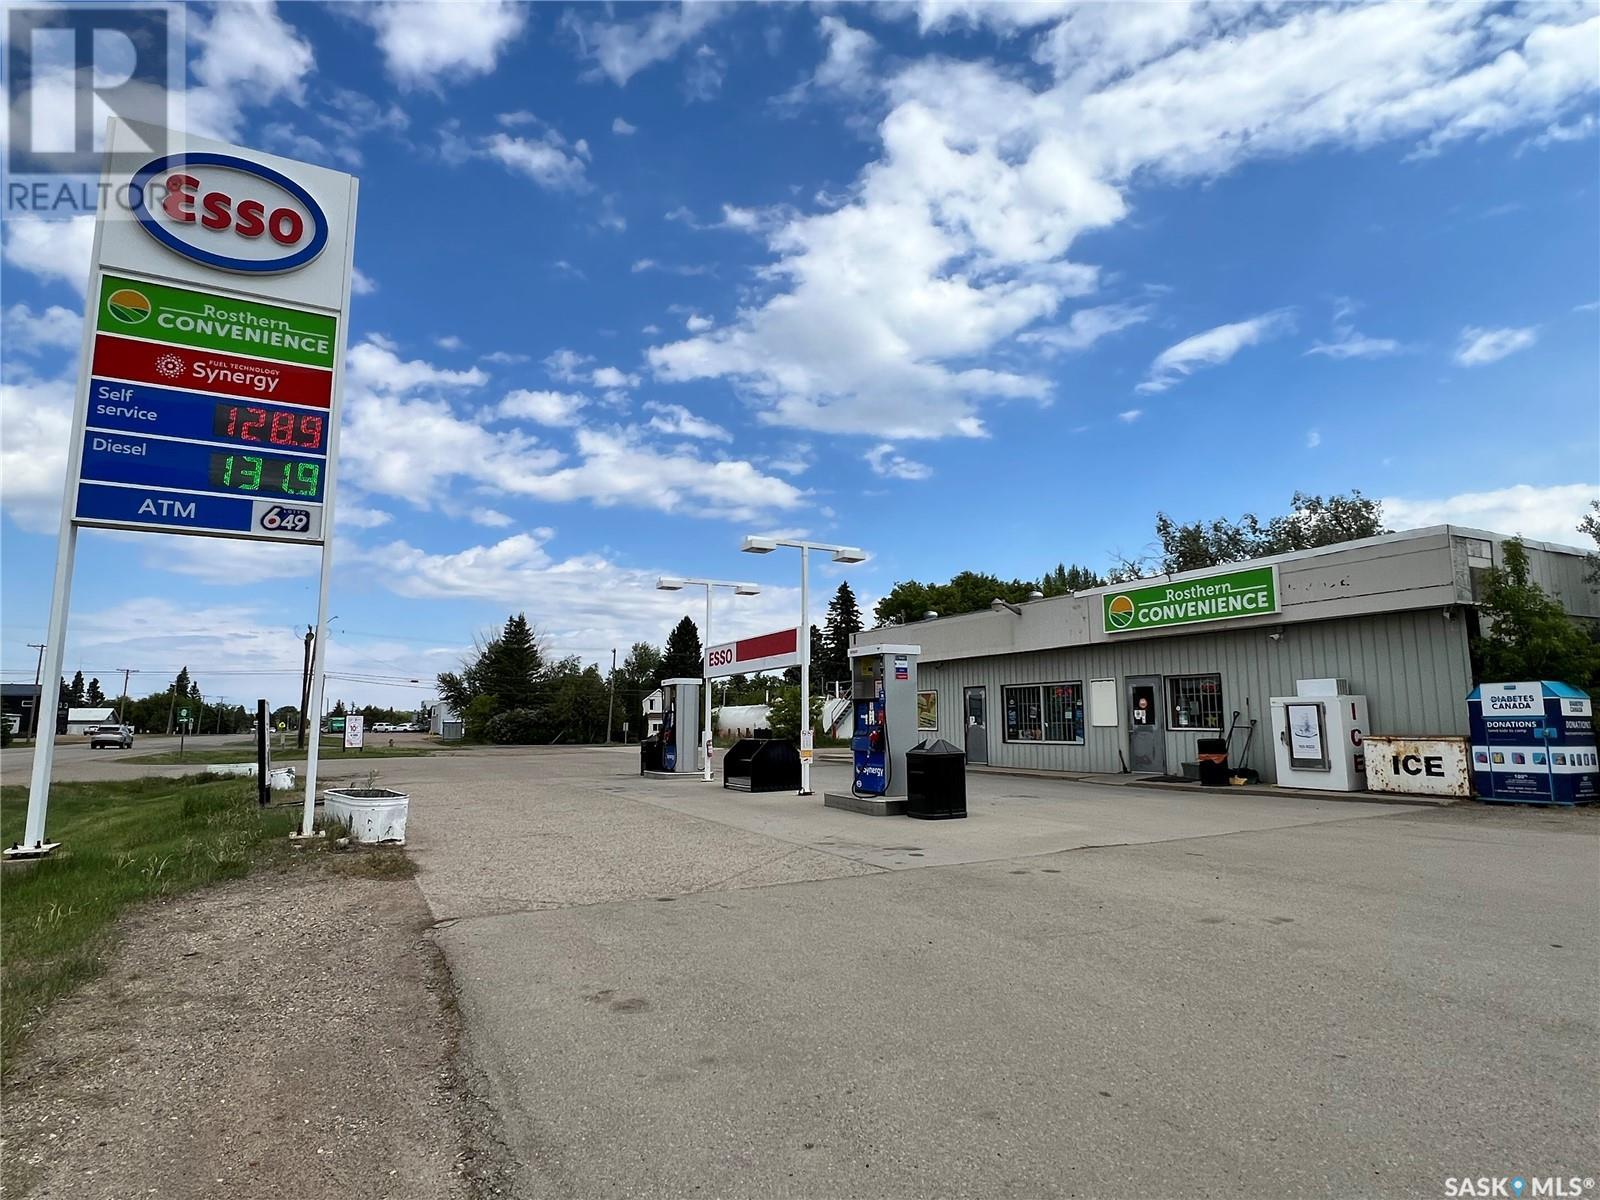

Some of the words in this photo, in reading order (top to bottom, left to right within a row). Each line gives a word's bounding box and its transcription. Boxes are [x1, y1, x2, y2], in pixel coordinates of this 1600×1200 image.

[203, 304, 289, 331] Rosthern
[157, 313, 329, 355] CONVENIENCE
[193, 362, 280, 392] Synergy
[208, 360, 229, 369] FUEL
[230, 362, 280, 376] TECHNOLOGY
[98, 386, 134, 402] Self
[97, 404, 158, 421] service
[93, 437, 147, 456] Diesel
[137, 498, 196, 519] ATM
[1166, 582, 1231, 602] Rosthern
[1138, 591, 1269, 623] CONVENIENCE
[709, 649, 733, 667] ESSO
[1490, 694, 1535, 703] DIABETES
[1491, 702, 1532, 710] CANADA
[1392, 754, 1446, 778] ICE
